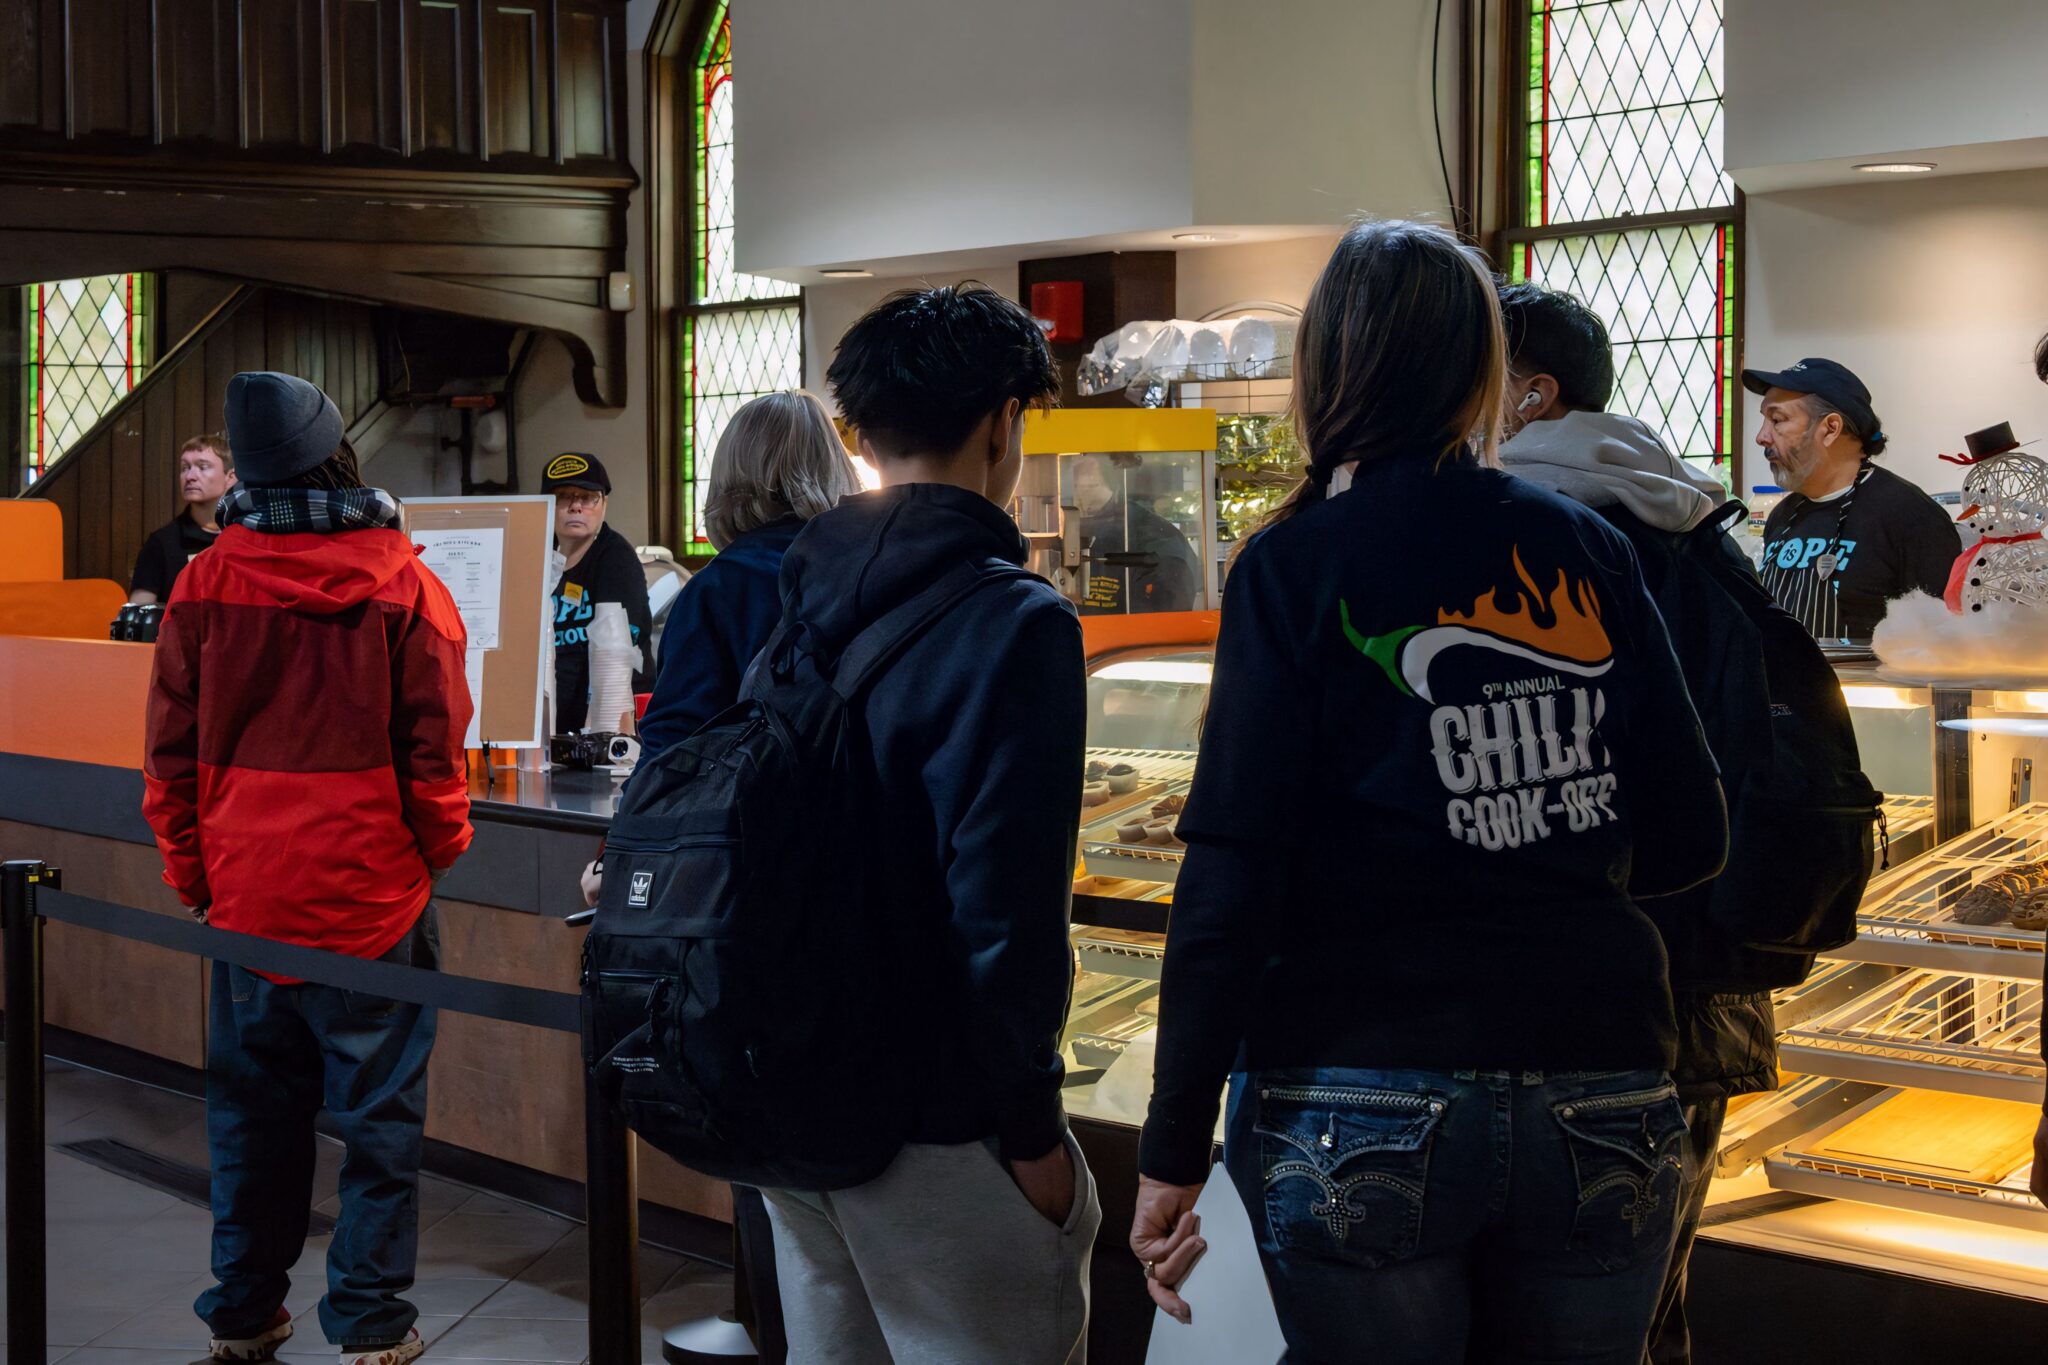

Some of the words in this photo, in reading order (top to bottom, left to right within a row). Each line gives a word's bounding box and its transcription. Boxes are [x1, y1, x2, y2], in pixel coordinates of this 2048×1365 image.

[1782, 543, 1797, 562] is
[1482, 682, 1502, 699] 9TH
[1505, 675, 1566, 698] ANNUAL
[1447, 772, 1619, 852] COOK-OFF
